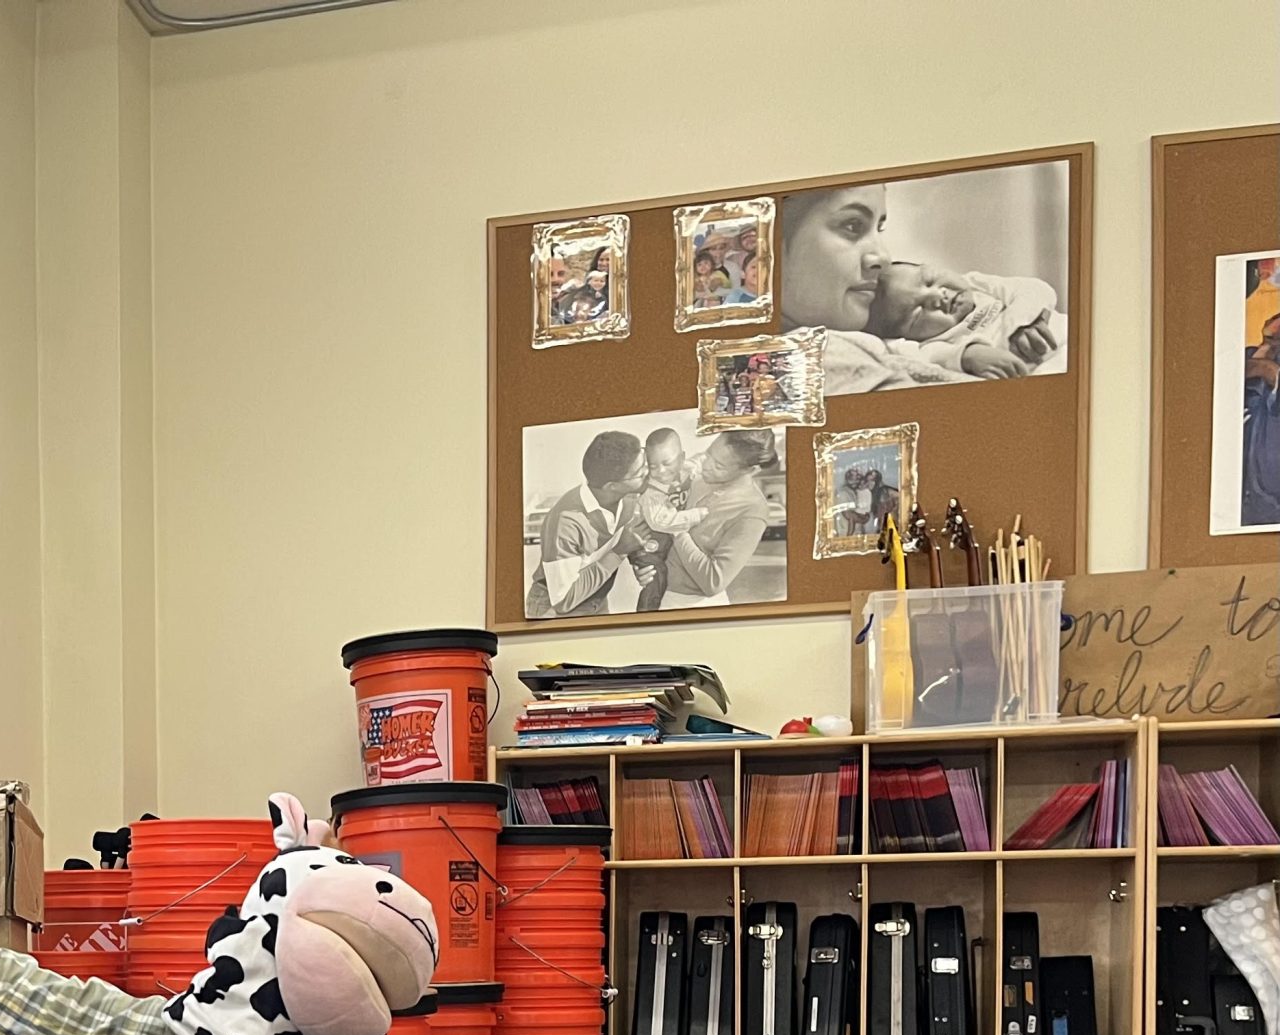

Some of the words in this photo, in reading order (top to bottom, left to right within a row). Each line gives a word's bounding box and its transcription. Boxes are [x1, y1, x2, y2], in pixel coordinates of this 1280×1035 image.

[1220, 576, 1280, 641] to
[380, 711, 436, 742] HOMER
[383, 738, 432, 760] BUCKET
